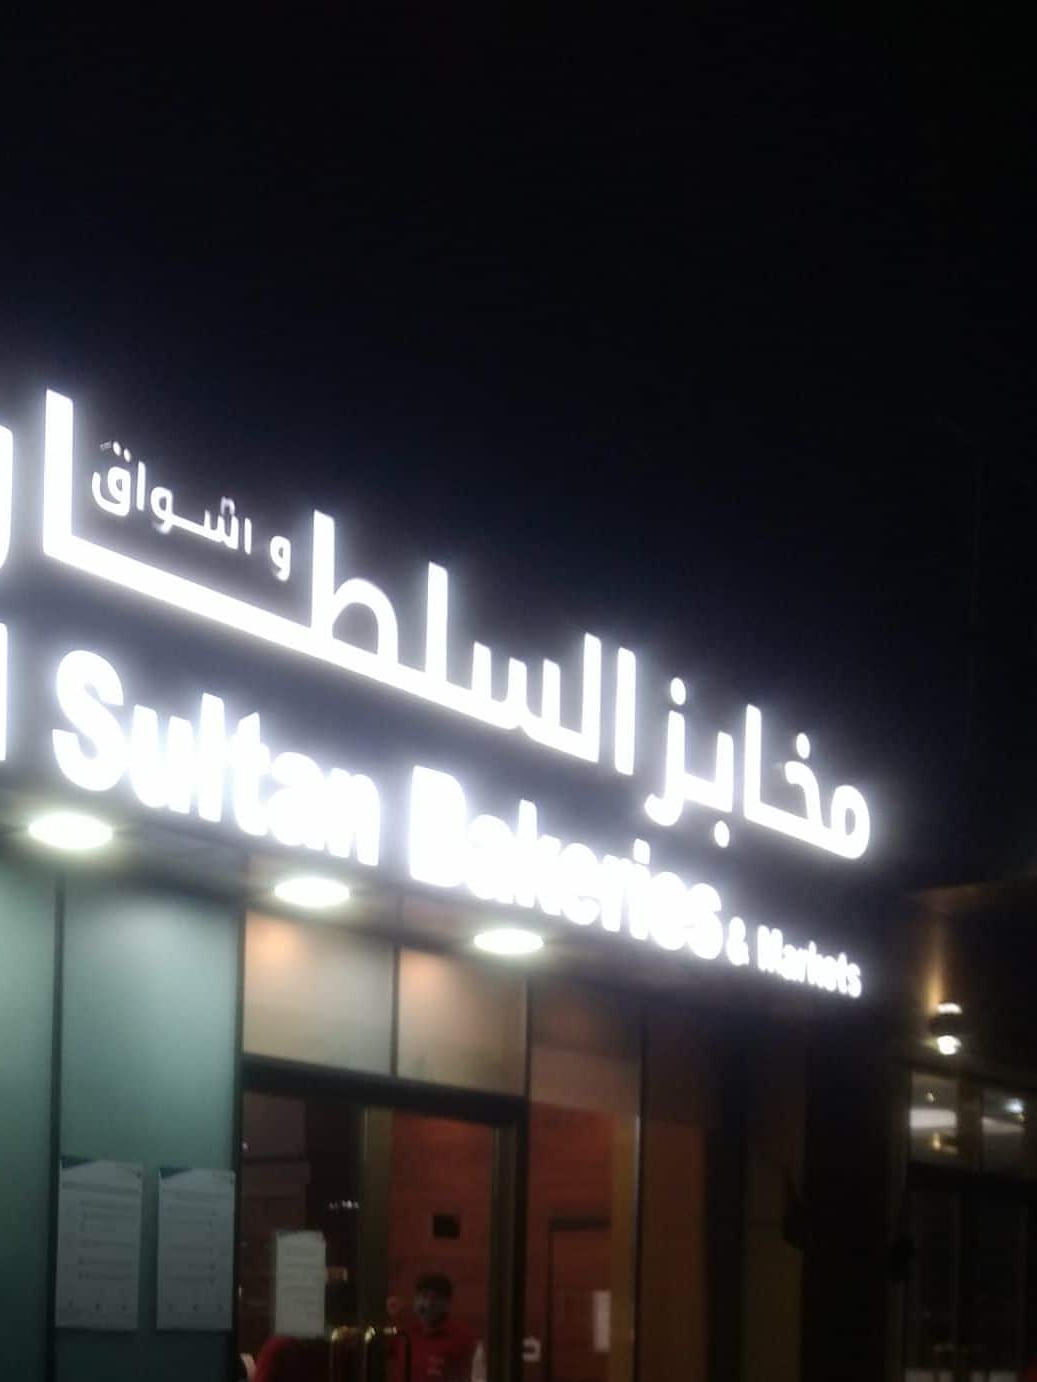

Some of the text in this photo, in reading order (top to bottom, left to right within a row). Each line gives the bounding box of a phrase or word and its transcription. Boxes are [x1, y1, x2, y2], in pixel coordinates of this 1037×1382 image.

[51, 648, 381, 867] Sultan
[410, 765, 724, 960] Bakeries
[726, 916, 750, 966] &
[757, 924, 862, 998] Markets
[644, 677, 871, 860] مخابز
